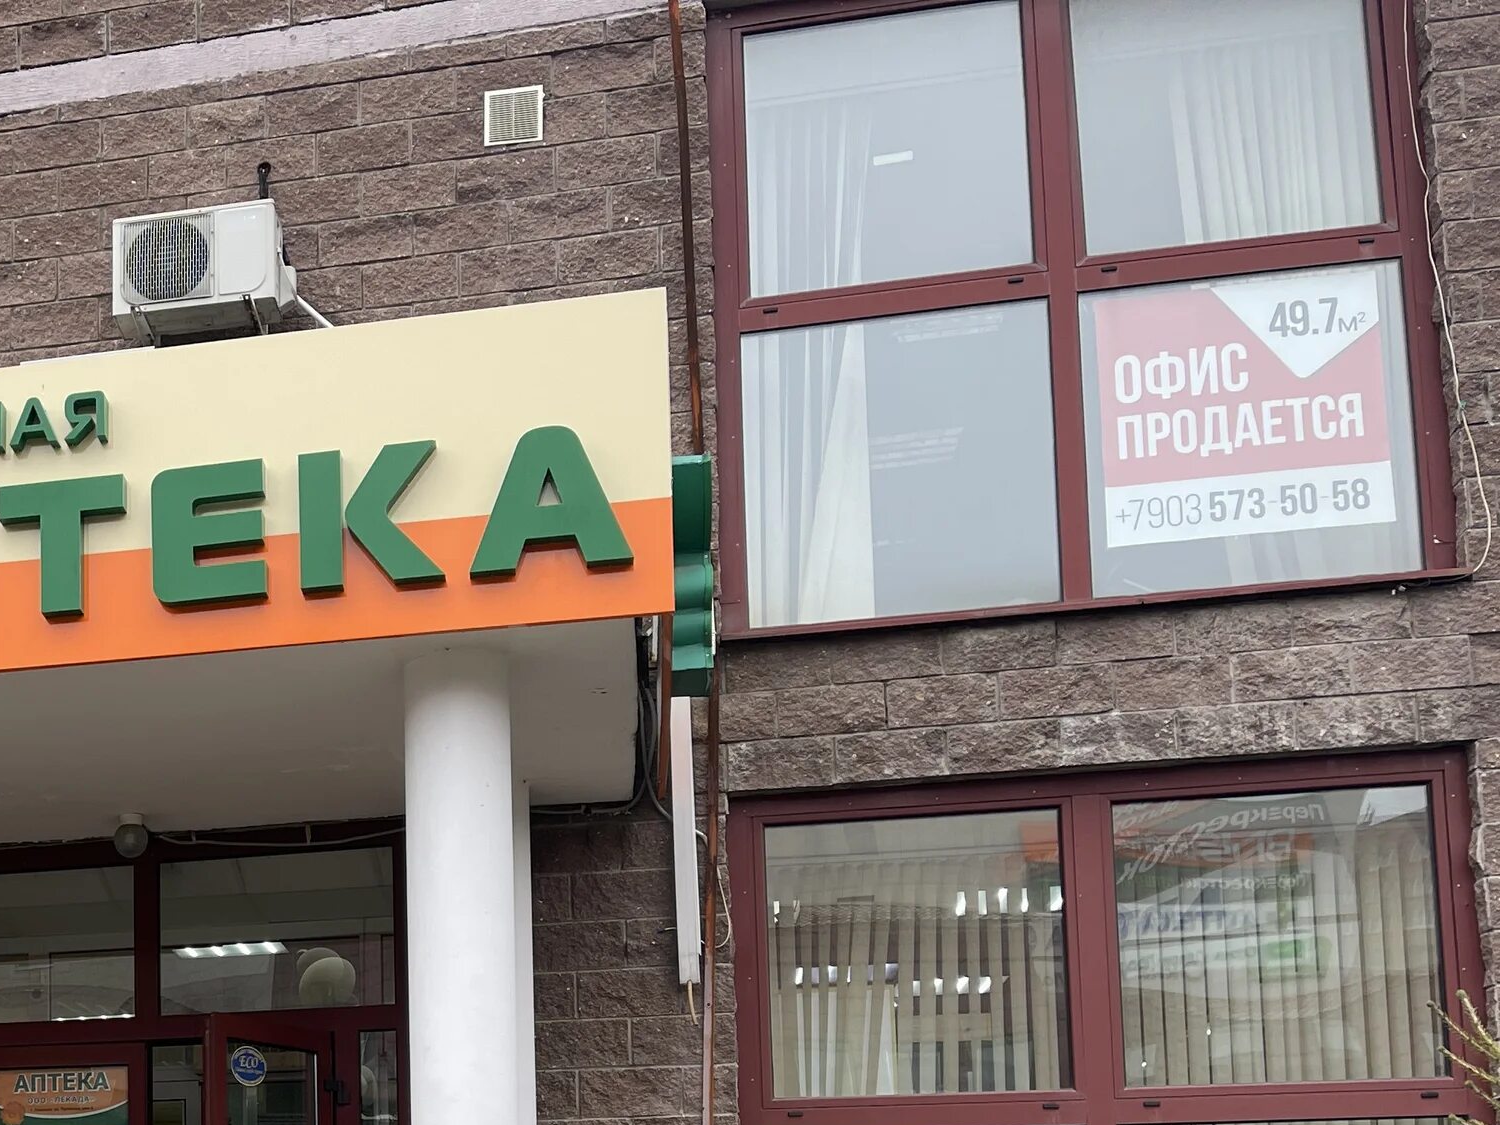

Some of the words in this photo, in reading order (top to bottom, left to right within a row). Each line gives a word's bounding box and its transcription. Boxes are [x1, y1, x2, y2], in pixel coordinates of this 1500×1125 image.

[1114, 342, 1249, 404] ОФИС
[1117, 393, 1365, 460] ПРОДАЕТСЯ
[1209, 478, 1370, 522] 573-50-58
[13, 1071, 111, 1094] АПТЕКА
